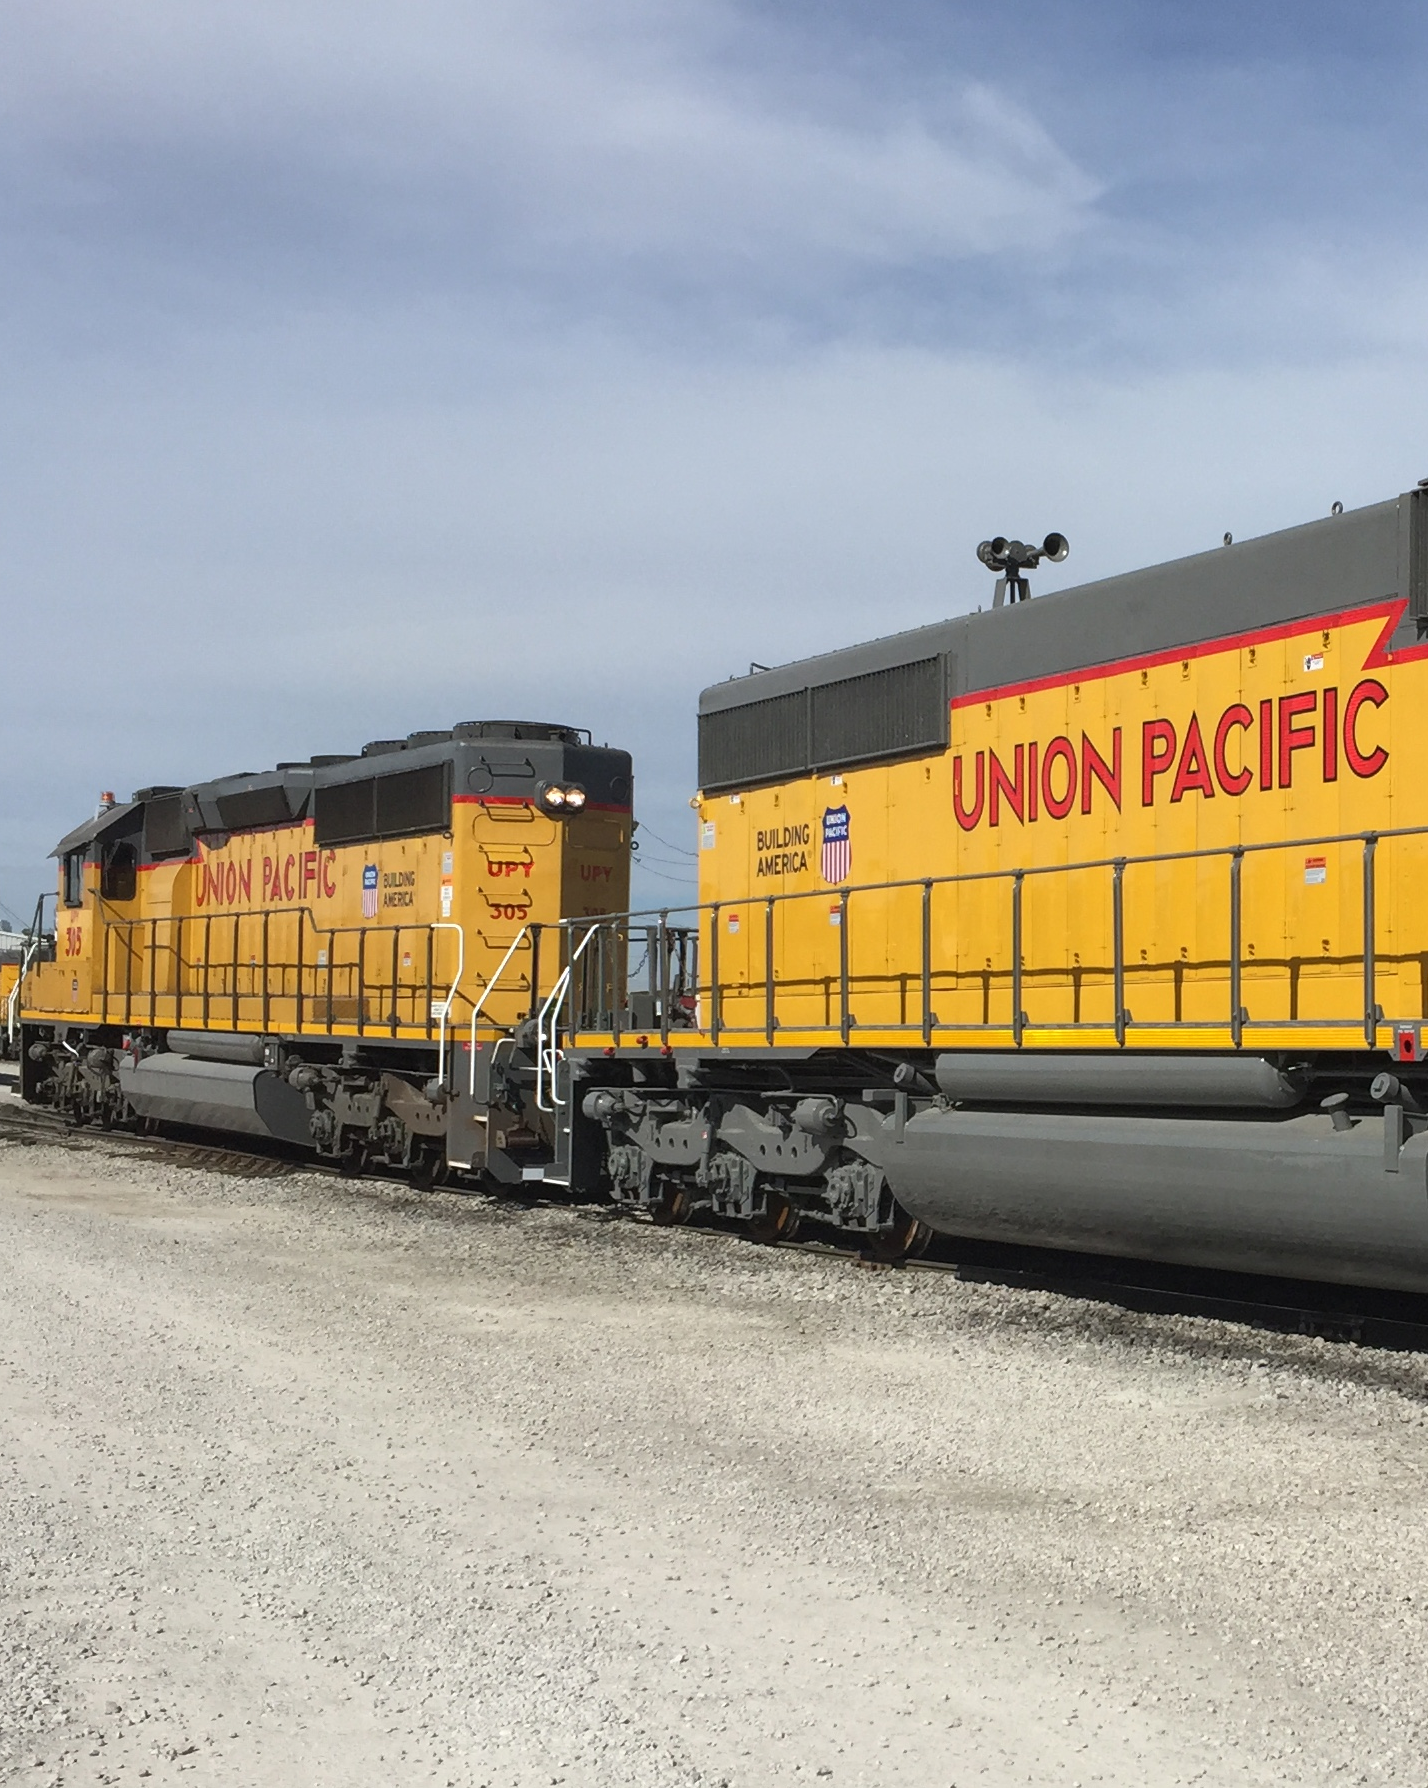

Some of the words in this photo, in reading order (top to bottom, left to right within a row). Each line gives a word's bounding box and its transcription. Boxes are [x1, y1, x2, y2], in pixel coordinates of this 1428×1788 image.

[952, 725, 1122, 832] UNION
[1141, 677, 1390, 808] PACIFIC
[756, 823, 810, 851] BUILDING
[487, 860, 535, 878] UPY
[756, 850, 809, 878] AMERICA
[195, 857, 252, 907] UNION
[262, 849, 337, 903] PACIFIC
[382, 870, 416, 889] BUILDING
[382, 890, 414, 908] AMERICA
[490, 905, 528, 921] 305
